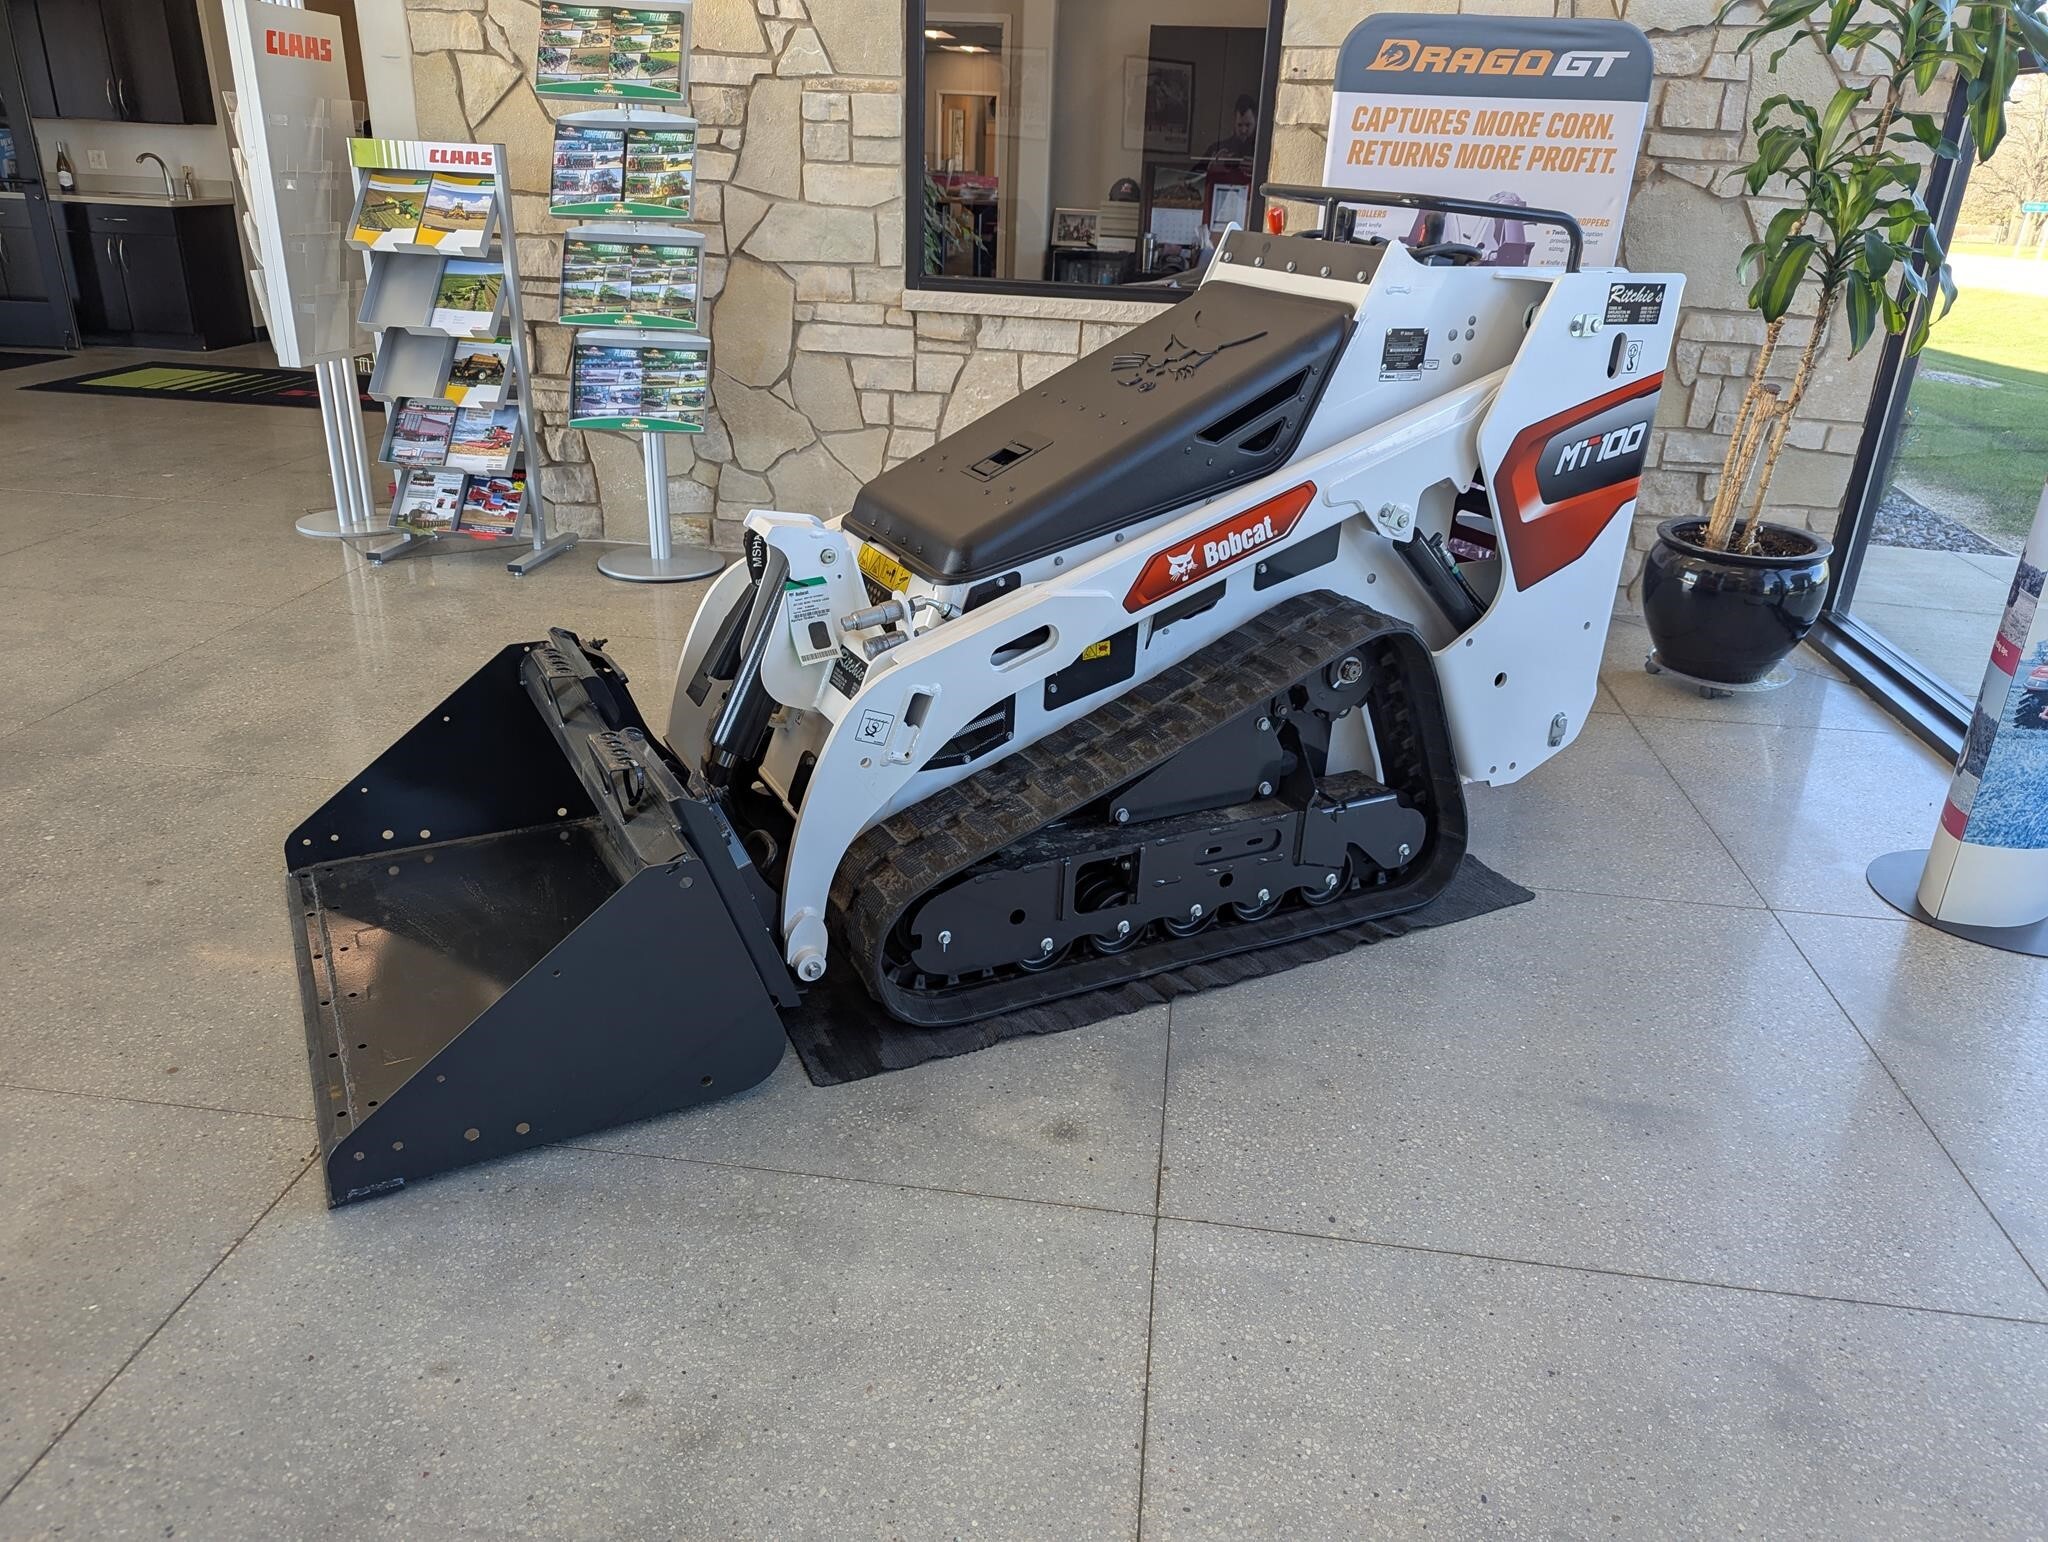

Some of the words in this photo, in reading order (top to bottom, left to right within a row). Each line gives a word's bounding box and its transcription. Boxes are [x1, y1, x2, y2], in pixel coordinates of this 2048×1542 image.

[578, 8, 600, 17] TILLAGE
[649, 12, 670, 22] TILLAGE
[266, 29, 332, 62] CLAAS
[1366, 38, 1554, 76] DRAGO
[1552, 50, 1631, 78] GT
[1350, 105, 1471, 136] CAPTURES
[1472, 109, 1544, 138] MORE
[1545, 112, 1615, 141] CORN.
[583, 129, 607, 139] COMPACT
[606, 130, 623, 139] DRILLS
[654, 132, 678, 141] COMPACT
[677, 133, 693, 142] DRILLS
[429, 149, 493, 166] CLAAS
[1346, 139, 1454, 169] RETURNS
[1454, 143, 1525, 172] MORE
[1526, 146, 1617, 175] PROFIT.
[613, 244, 630, 253] DRILLS
[678, 247, 695, 256] DRILLS
[1608, 284, 1663, 303] Ritchie's
[613, 349, 638, 358] PLANTERS
[674, 351, 698, 360] PLANTERS
[1203, 515, 1274, 568] Bobcat
[752, 534, 763, 568] MSHA
[837, 647, 865, 681] Ritchie
